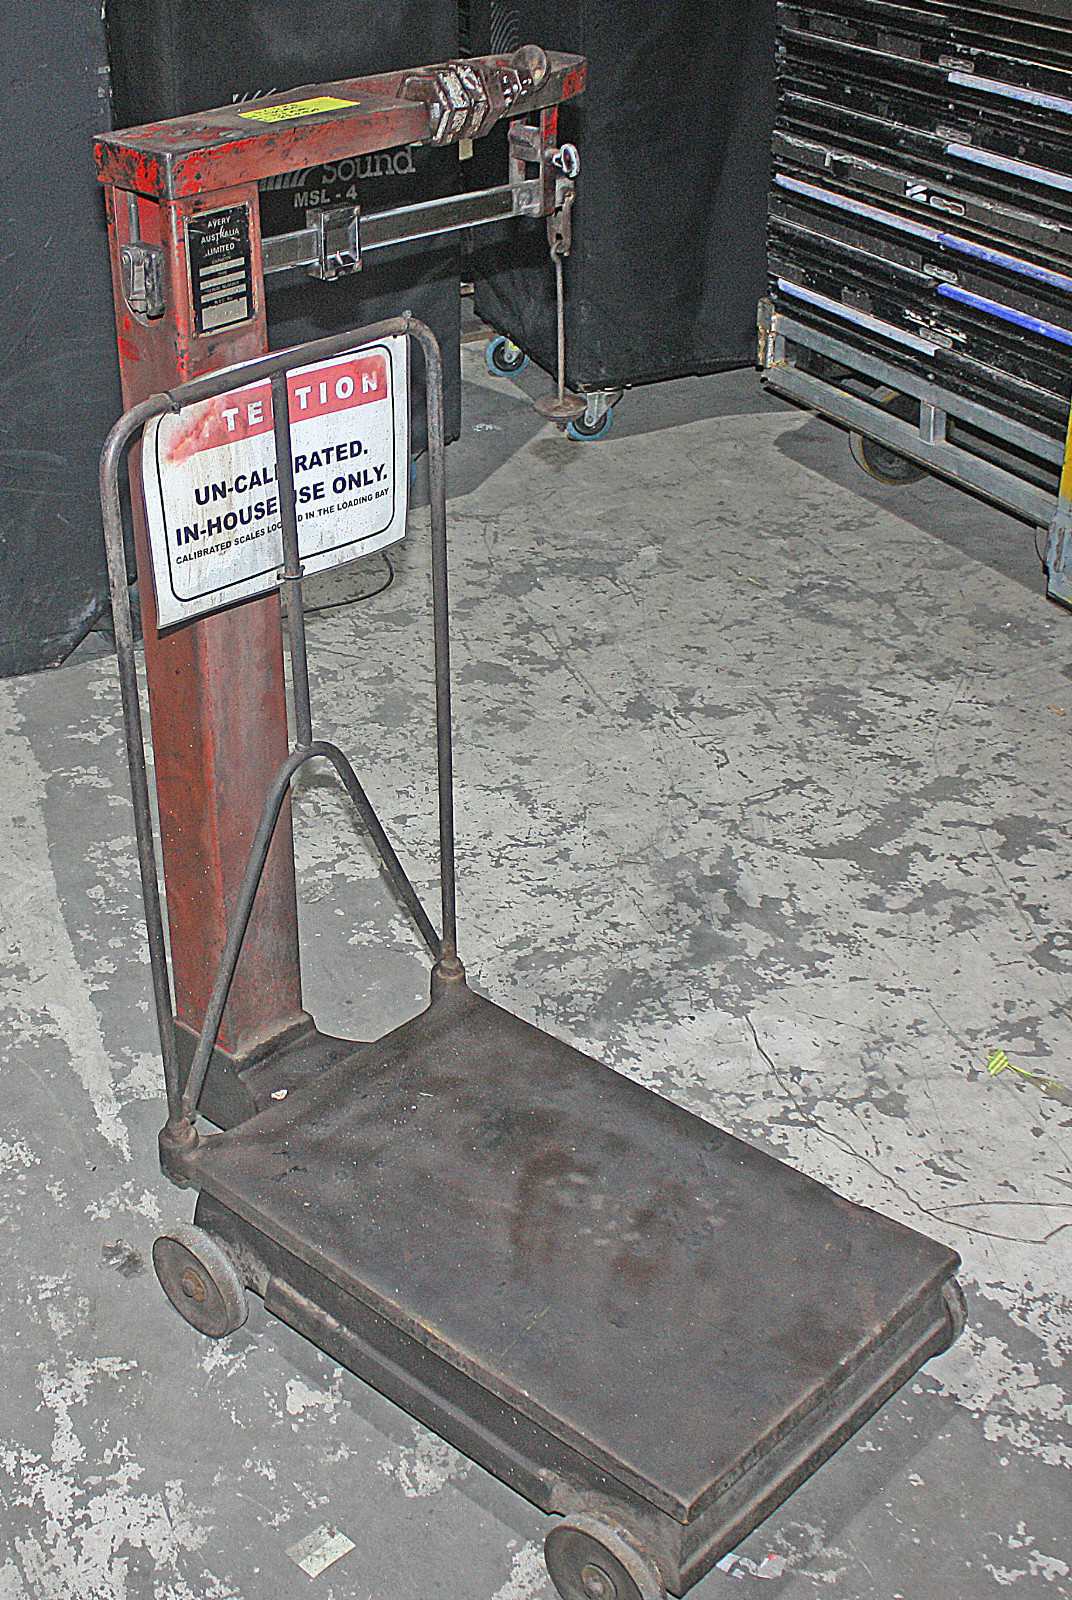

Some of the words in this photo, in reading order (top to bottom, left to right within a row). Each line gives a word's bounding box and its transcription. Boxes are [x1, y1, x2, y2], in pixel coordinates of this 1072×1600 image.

[294, 189, 330, 208] MSL
[346, 184, 358, 200] 4
[207, 216, 231, 228] AVERY
[201, 226, 240, 244] AUSTRALIA
[207, 243, 235, 256] LIMITED
[194, 440, 368, 506] UN-CALIRATED.
[176, 496, 278, 546] IN-HOUSE
[292, 481, 326, 505] SE
[332, 463, 388, 493] ONLY.
[175, 539, 232, 565] CALIBRATED
[234, 527, 265, 547] SCALES
[267, 514, 303, 534] LOCD
[305, 510, 315, 521] IN
[317, 504, 335, 518] THE
[336, 493, 373, 514] LOADING
[374, 487, 390, 500] BAY
